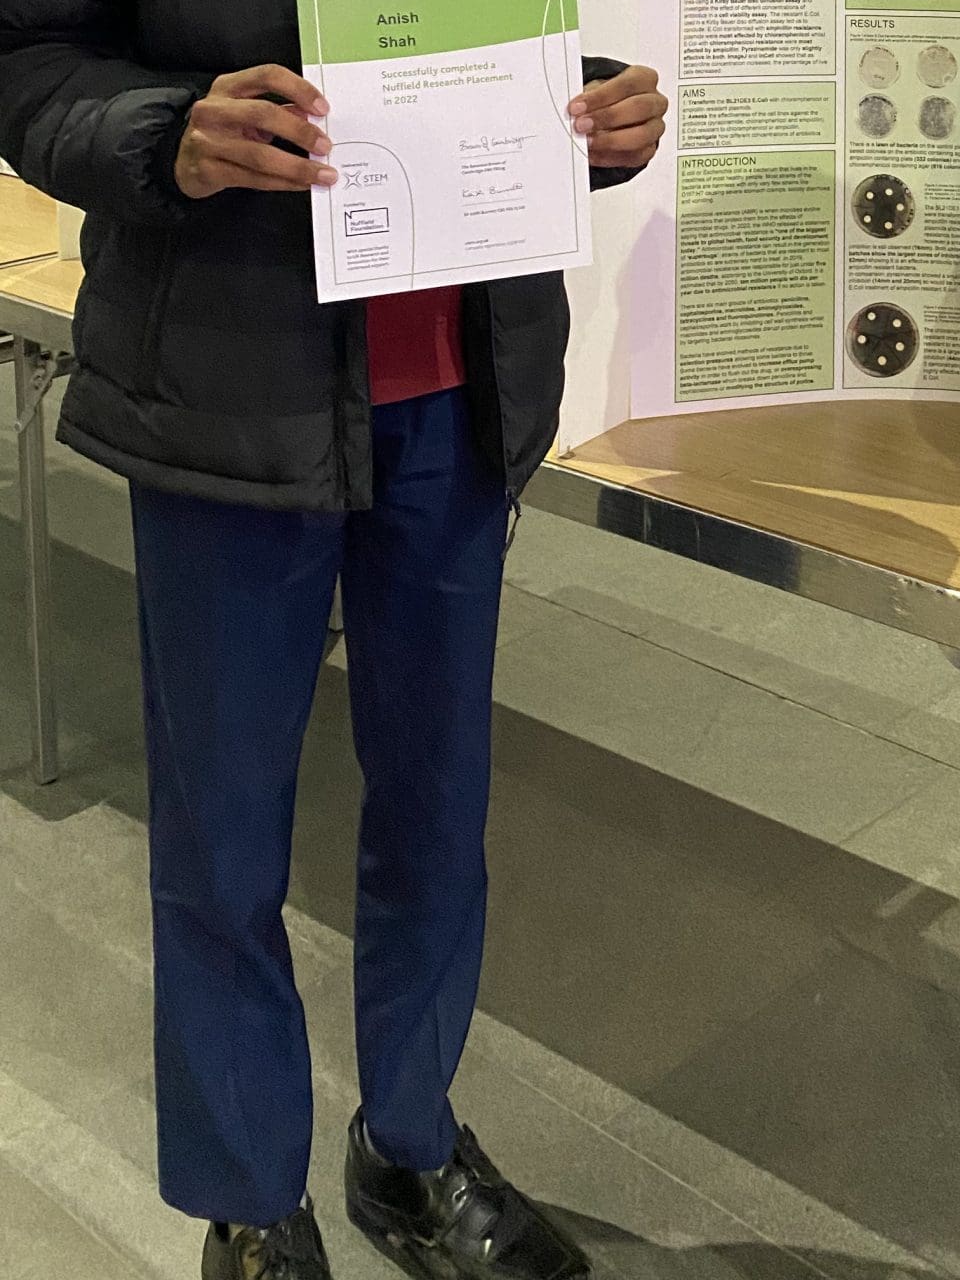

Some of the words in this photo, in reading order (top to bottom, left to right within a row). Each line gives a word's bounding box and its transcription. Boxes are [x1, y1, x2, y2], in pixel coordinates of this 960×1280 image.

[377, 12, 419, 26] Anish
[850, 19, 895, 28] RESULTS
[379, 35, 416, 48] Shah
[381, 66, 438, 79] Successfully
[440, 61, 489, 74] completed
[490, 62, 496, 70] a
[382, 80, 421, 93] Nuffield
[423, 77, 465, 89] Research
[466, 72, 514, 84] Placement
[682, 89, 706, 98] AIMS
[383, 97, 392, 106] in
[395, 94, 418, 105] 2022
[682, 157, 757, 169] INTRODUCTION
[363, 174, 388, 183] STEM
